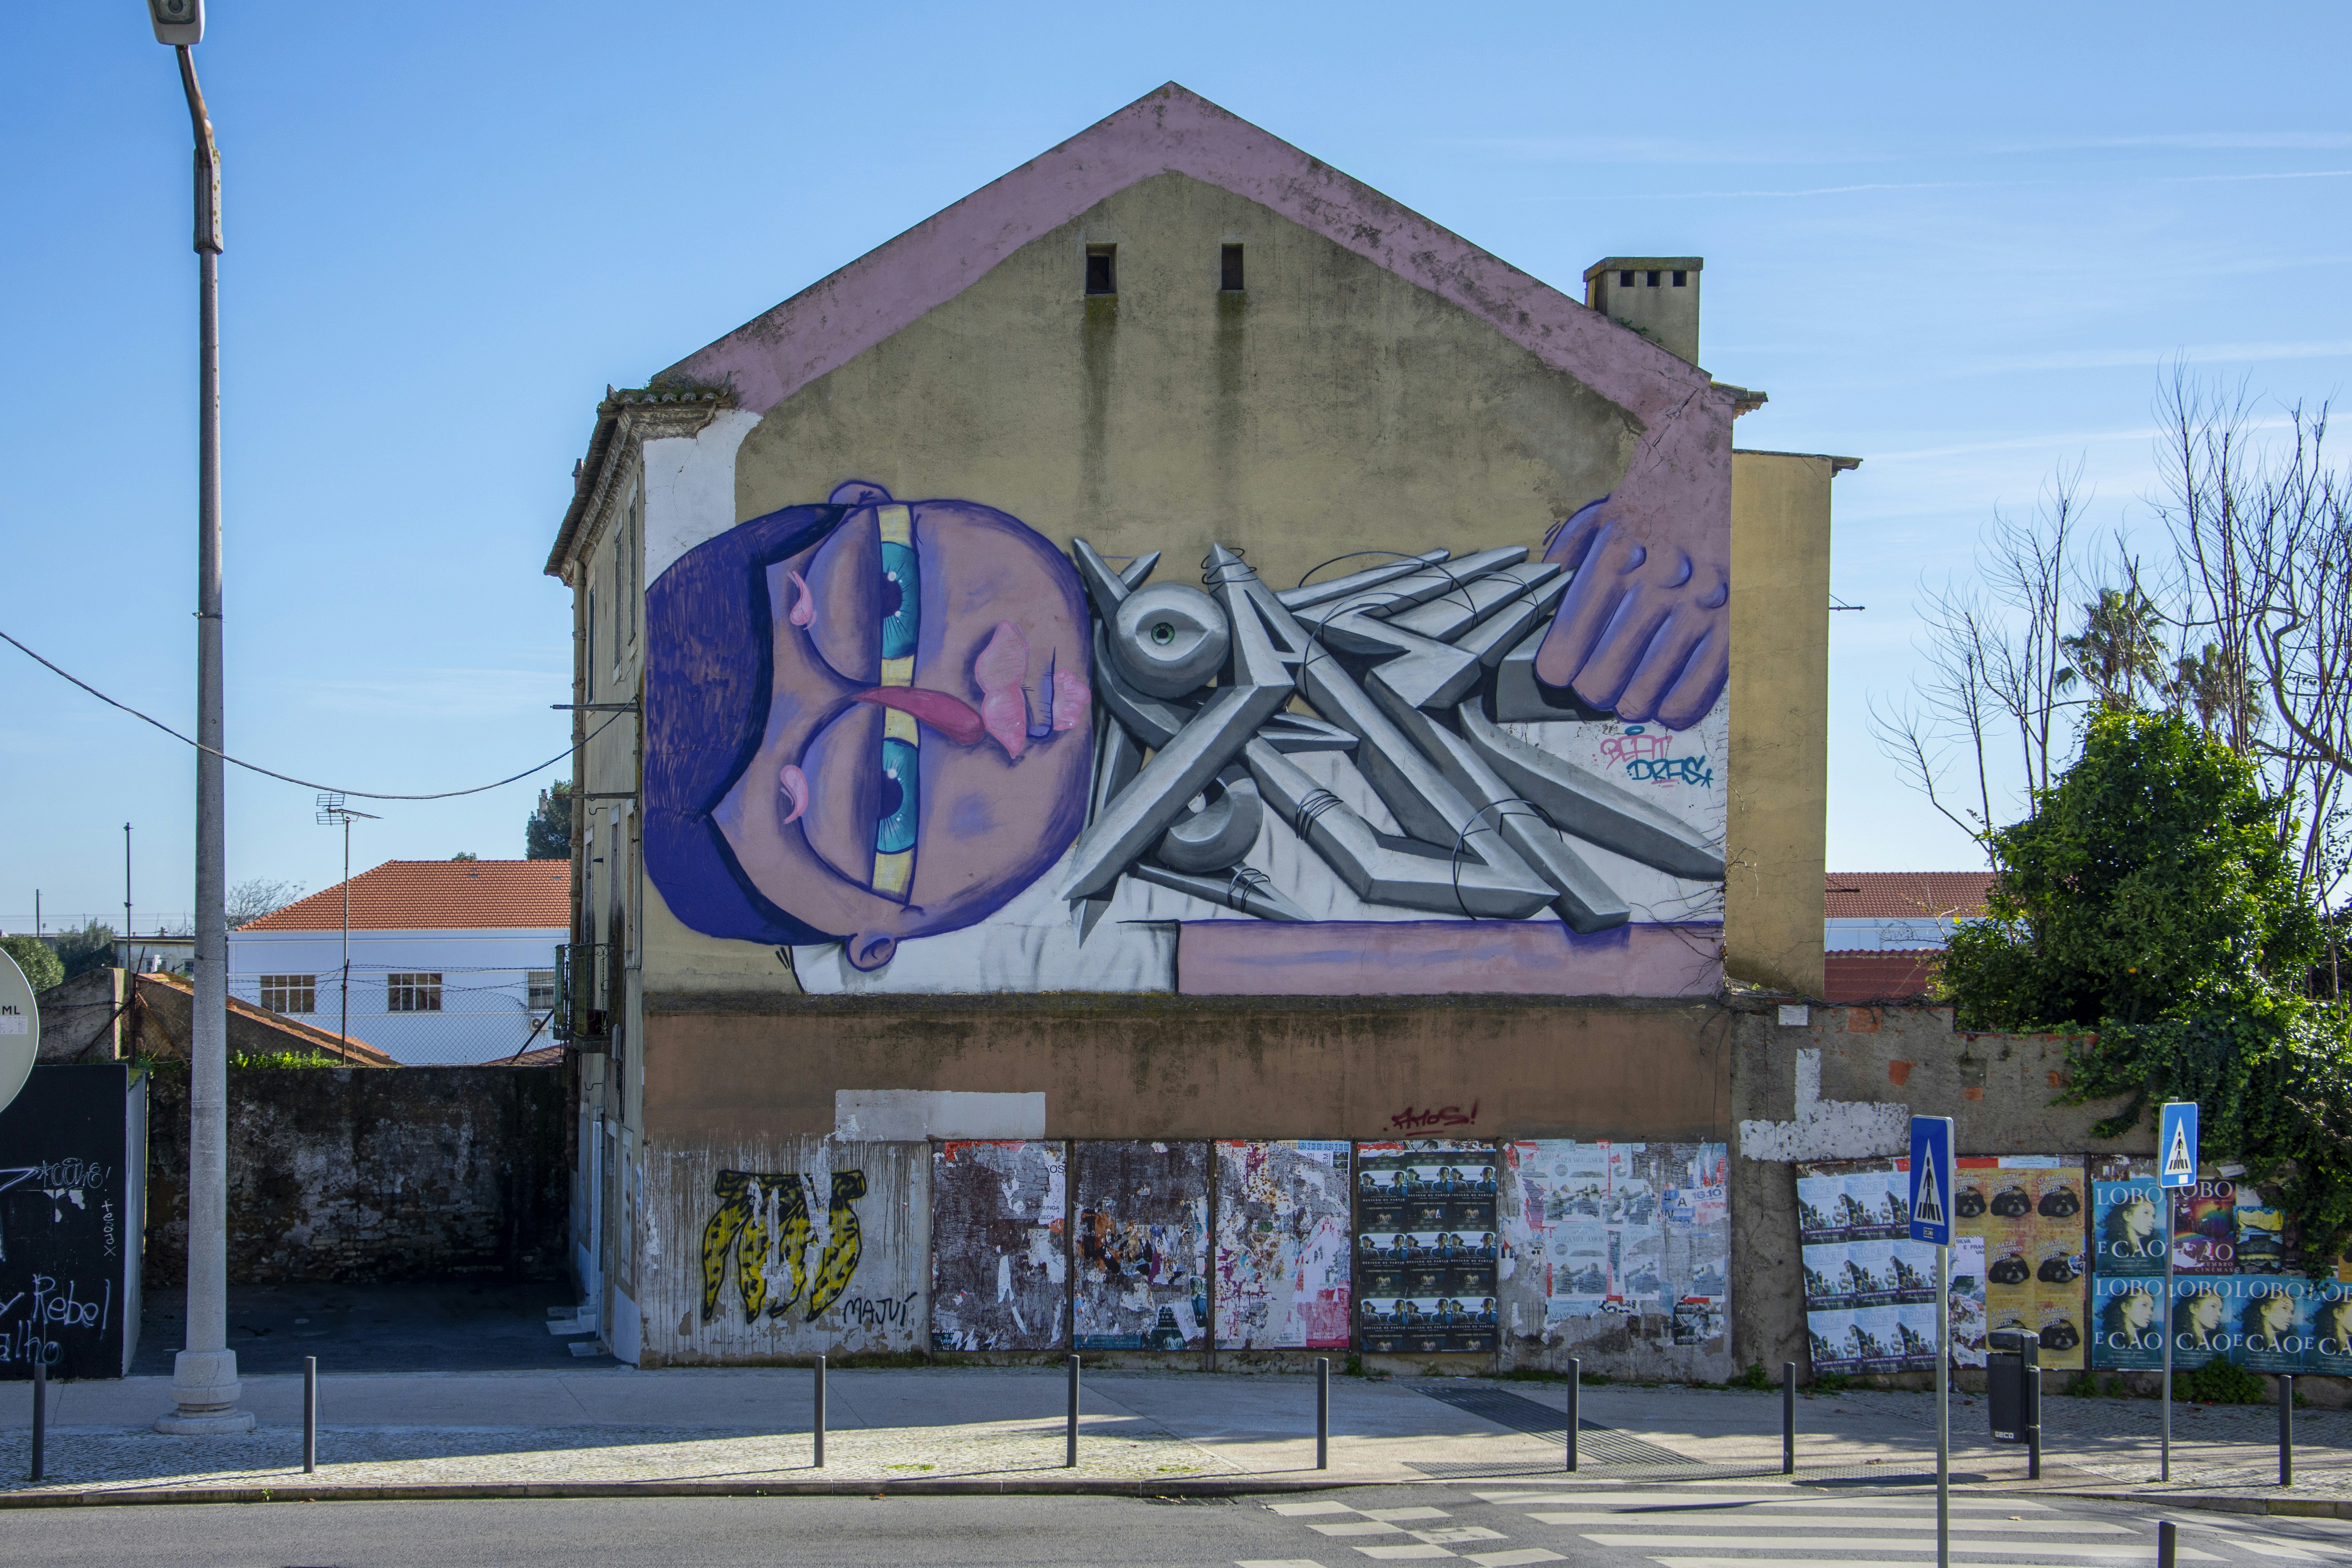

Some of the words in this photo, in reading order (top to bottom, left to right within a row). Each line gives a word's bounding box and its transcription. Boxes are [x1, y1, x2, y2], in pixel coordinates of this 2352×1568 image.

[0, 1005, 20, 1015] ML
[1048, 1165, 1064, 1173] OS
[2096, 1187, 2164, 1205] LOBO
[2174, 1181, 2233, 1198] OBO
[1996, 1240, 2017, 1249] NATAL
[2098, 1241, 2107, 1254] E
[2096, 1279, 2163, 1297] LOBO
[2172, 1280, 2232, 1298] OBO
[2235, 1281, 2305, 1300] LOBO
[2095, 1332, 2103, 1344] E
[2233, 1334, 2242, 1347] E
[2305, 1337, 2314, 1349] E
